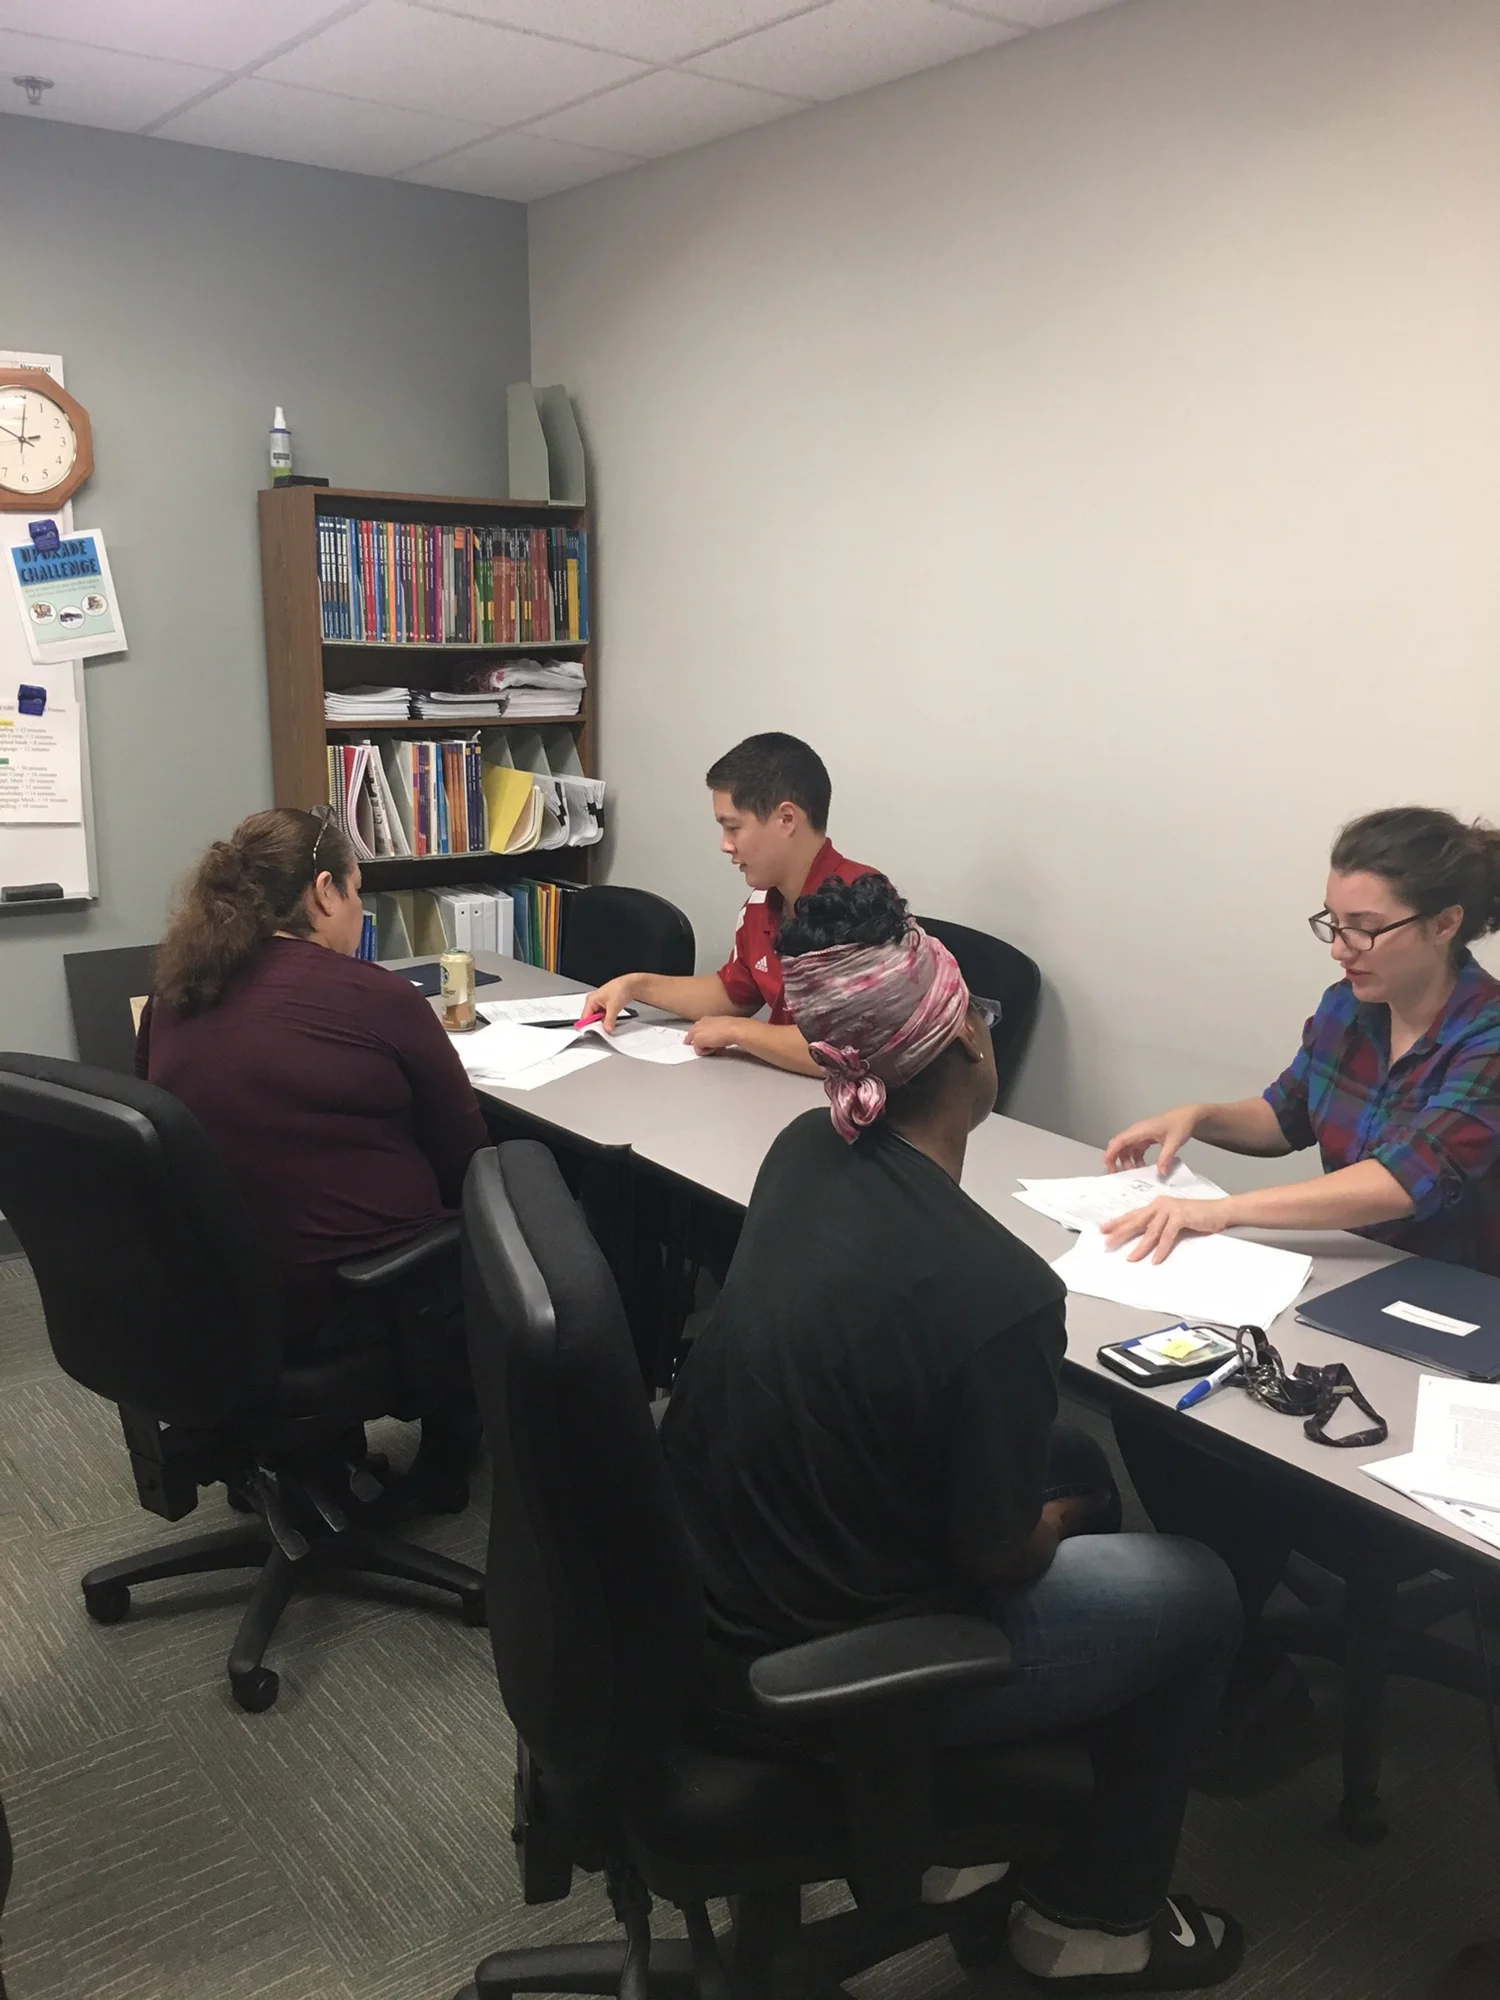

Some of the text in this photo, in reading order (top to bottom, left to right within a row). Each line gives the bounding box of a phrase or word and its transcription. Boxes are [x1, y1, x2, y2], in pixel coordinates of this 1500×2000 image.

[53, 417, 60, 429] 2
[60, 436, 66, 448] 3
[55, 455, 62, 465] 4
[1, 466, 8, 478] 7
[42, 468, 49, 480] 5
[21, 473, 29, 484] 6
[21, 558, 98, 583] CHALLENGE
